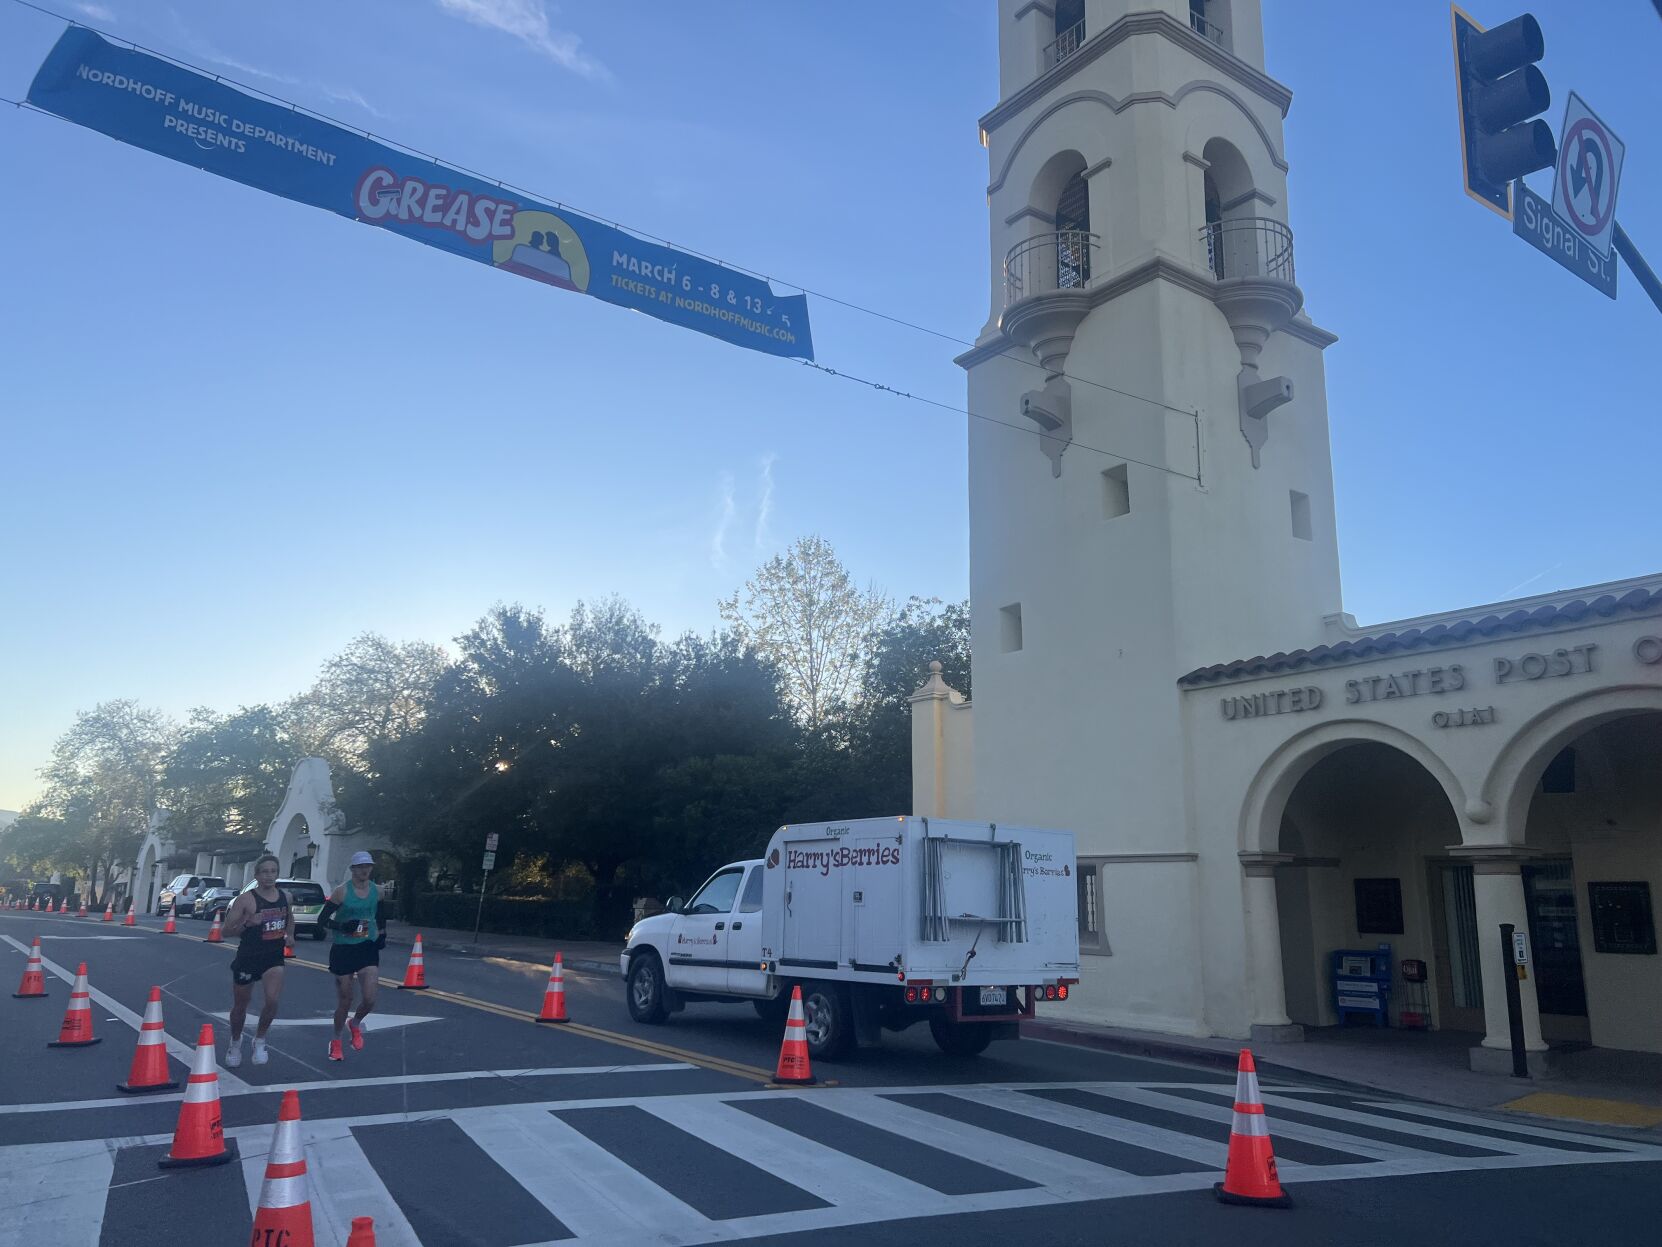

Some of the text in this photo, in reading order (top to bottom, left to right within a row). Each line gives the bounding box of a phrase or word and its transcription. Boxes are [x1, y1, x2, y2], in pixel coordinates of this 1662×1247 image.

[76, 63, 337, 167] NORDHOFF MUSIC DEPARTMENT
[163, 115, 246, 153] PRESENTS
[359, 168, 517, 241] GREASE
[1523, 195, 1611, 282] Signal St.
[611, 274, 796, 345] TICKETS AT NORDHOFFMUSIC.COM
[612, 250, 676, 286] MARCH
[682, 275, 692, 292] 6
[710, 283, 720, 299] 8
[727, 289, 737, 306] &
[744, 295, 762, 314] 13
[1220, 685, 1323, 721] UNITED
[1344, 664, 1466, 704] STATES
[1493, 643, 1598, 684] POST
[1431, 705, 1495, 729] OJAI
[826, 826, 850, 838] Organic
[1025, 850, 1053, 864] Organic
[252, 1228, 291, 1247] PTC
